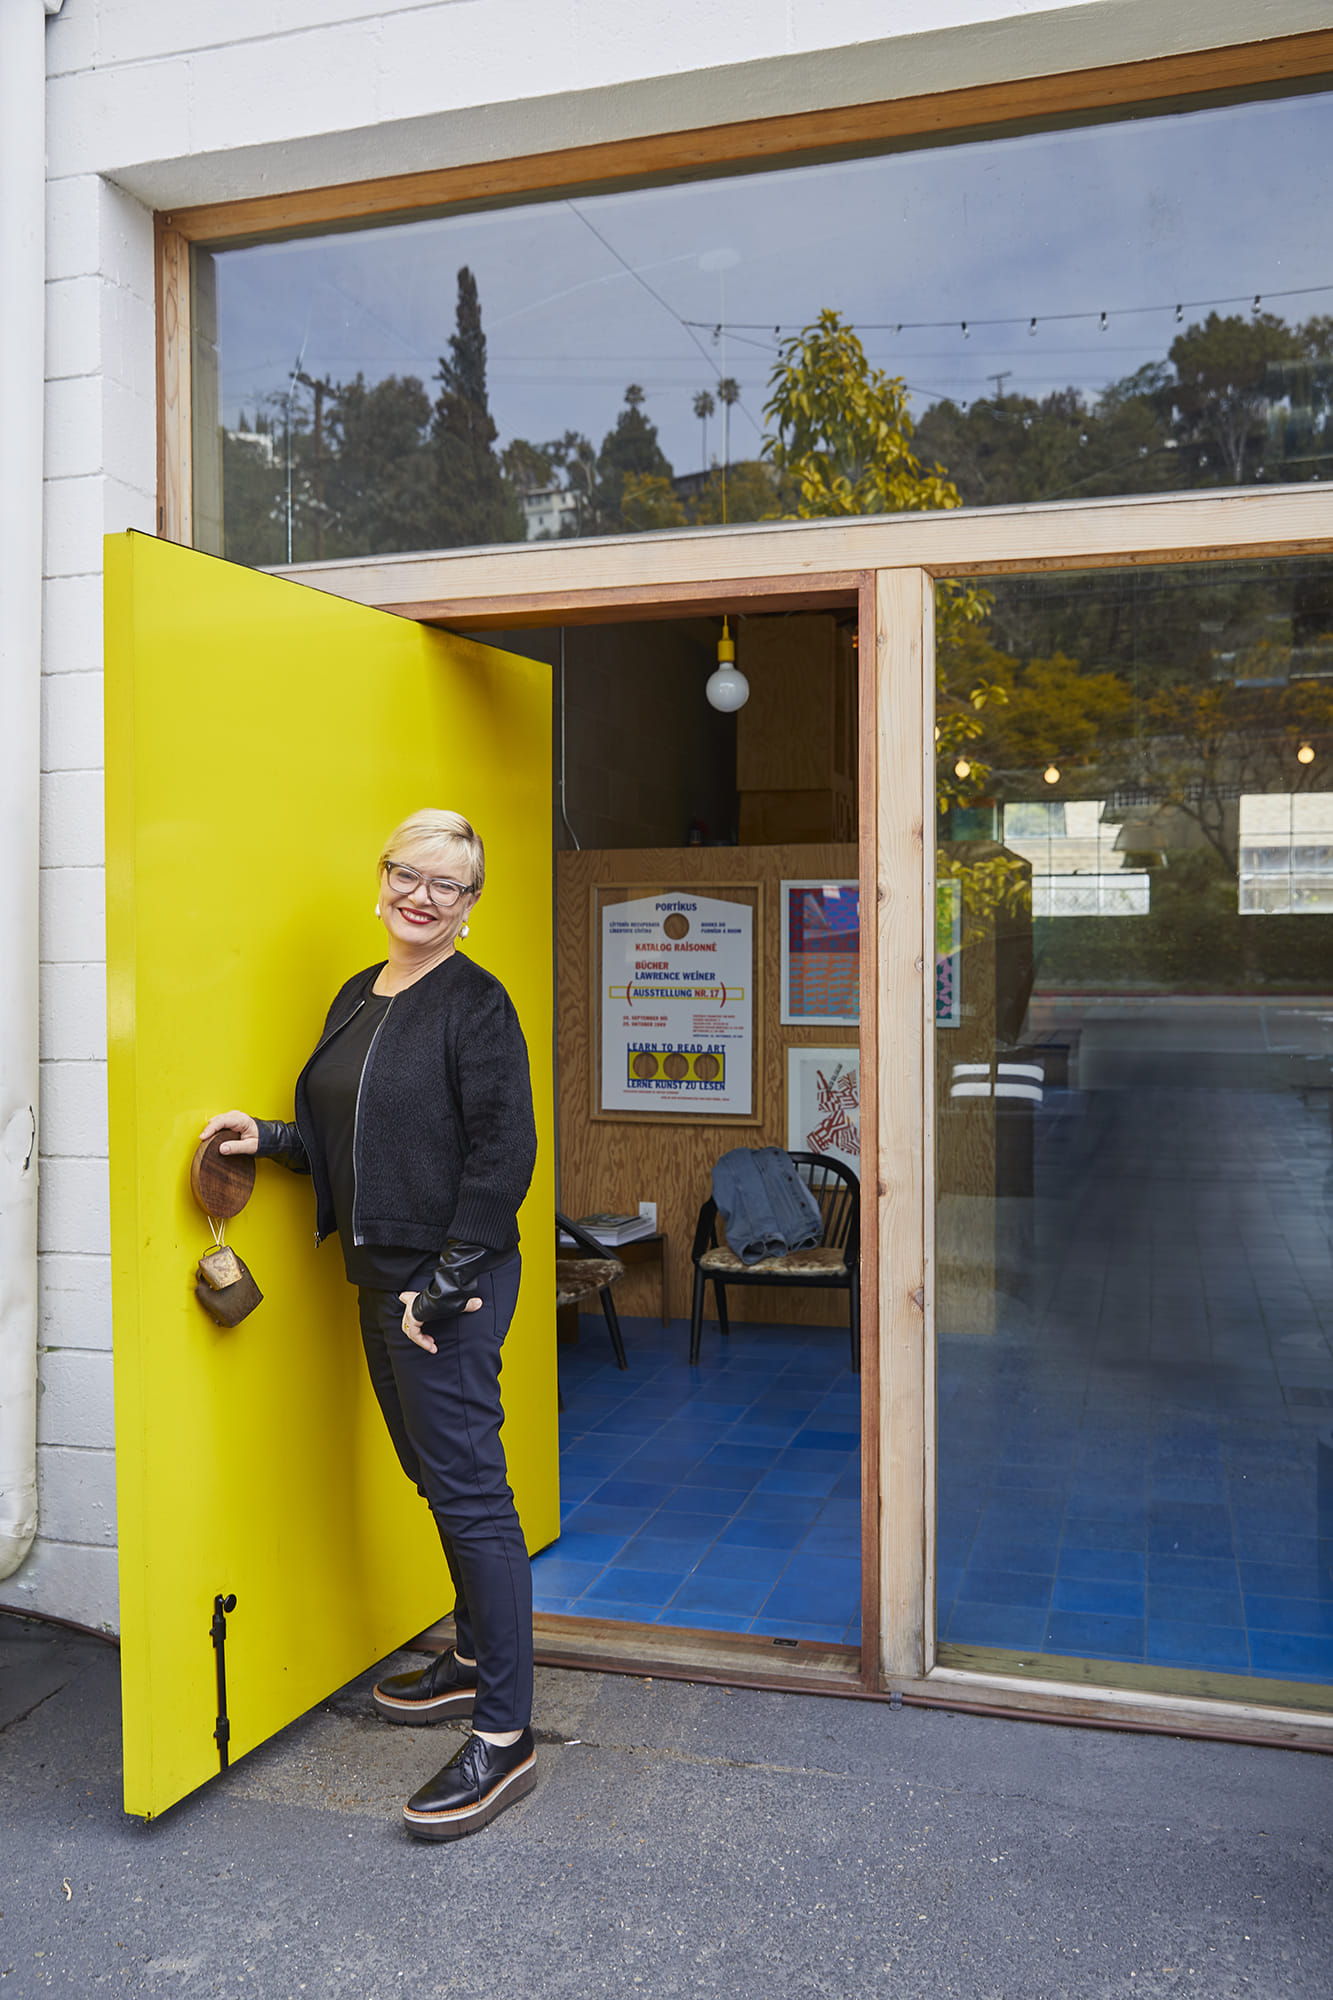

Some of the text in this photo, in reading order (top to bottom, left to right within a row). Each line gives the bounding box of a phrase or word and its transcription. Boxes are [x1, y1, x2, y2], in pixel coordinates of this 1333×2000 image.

[635, 943, 672, 952] KATALOG
[635, 960, 669, 970] BÜCHER
[635, 972, 680, 981] LAWRENCE
[694, 989, 709, 998] NR.
[627, 1042, 726, 1053] LEARN TO READ ART
[627, 1079, 726, 1091] LERNE KUNST ZU LESEN
